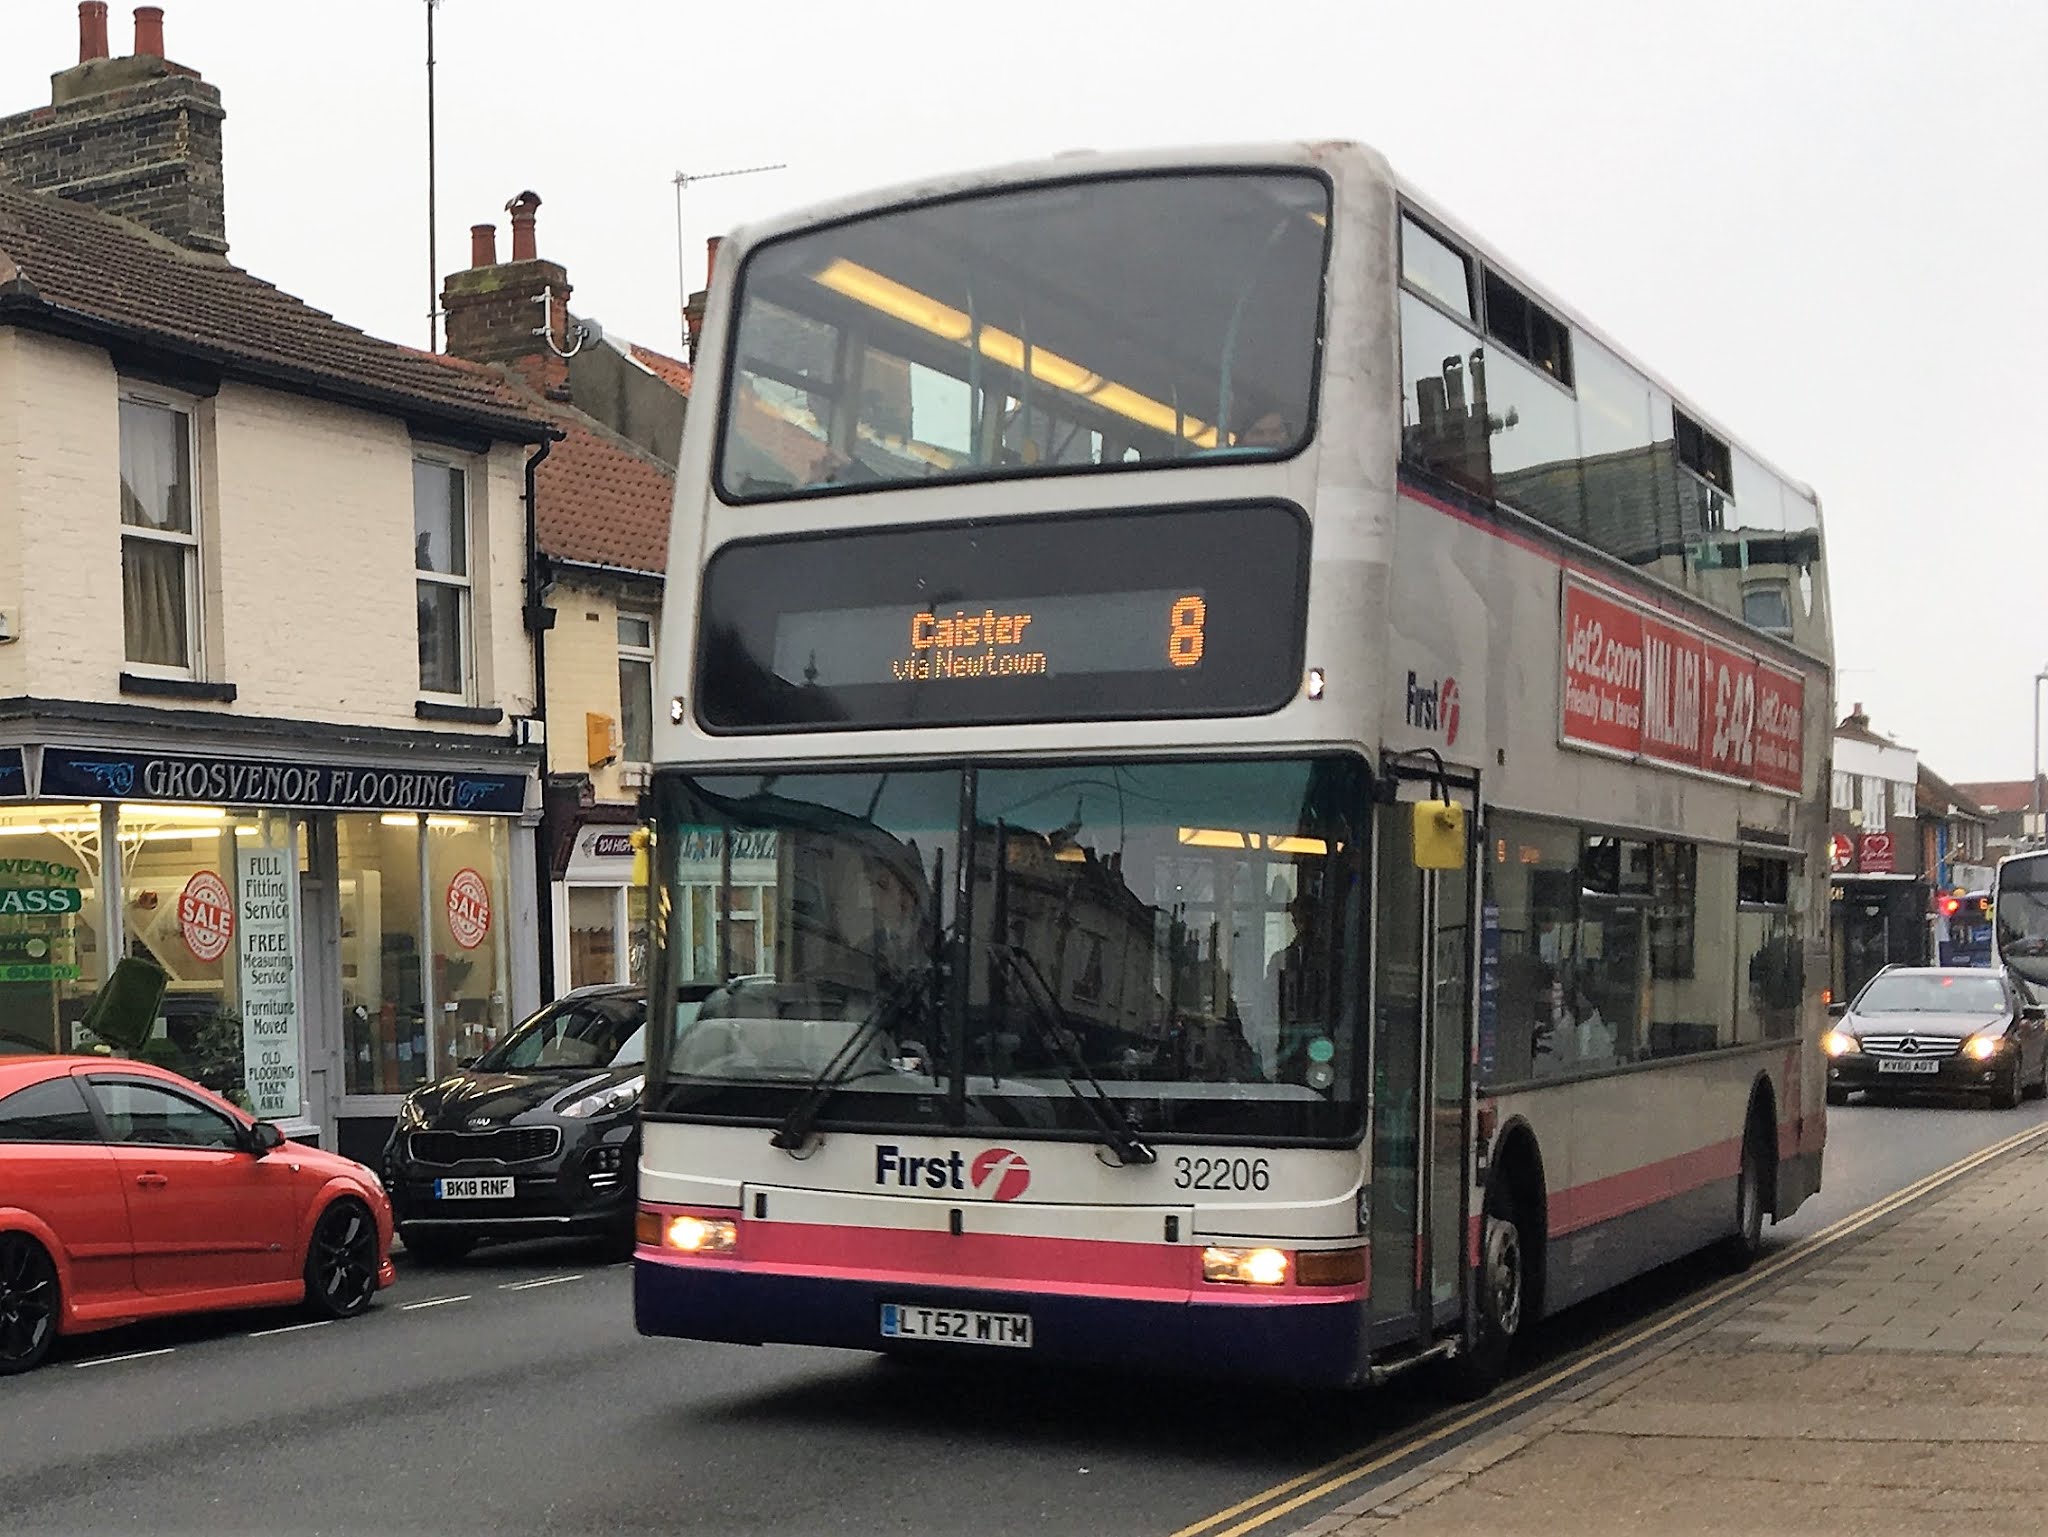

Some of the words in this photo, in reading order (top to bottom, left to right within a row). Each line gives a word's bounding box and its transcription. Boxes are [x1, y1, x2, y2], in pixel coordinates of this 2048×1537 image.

[911, 608, 1032, 650] Caister
[1168, 595, 1206, 667] 8
[893, 651, 930, 680] via
[935, 647, 1047, 679] Newtown
[1567, 614, 1641, 691] Jet2.com
[1406, 669, 1438, 731] First
[144, 760, 320, 802] GROSVENOR
[326, 770, 456, 807] FLOORING
[0, 858, 78, 882] VENOR
[250, 857, 281, 876] FULL
[0, 889, 71, 912] ASS
[246, 878, 288, 903] Fitting
[182, 898, 231, 936] SALE
[244, 900, 290, 920] Service
[449, 889, 488, 932] SALE
[249, 933, 287, 953] FREE
[243, 953, 294, 971] Measuring
[251, 968, 287, 985] Service
[245, 999, 295, 1016] Furniture
[254, 1018, 288, 1035] Moved
[262, 1050, 281, 1066] OLD
[249, 1065, 294, 1081] FLOORING
[258, 1081, 287, 1096] TAKEN
[260, 1096, 284, 1110] AWAY
[875, 1144, 965, 1190] First
[1174, 1156, 1270, 1192] 32206
[446, 1180, 477, 1197] BK18
[482, 1179, 509, 1196] RNF
[900, 1308, 968, 1338] LT52
[976, 1313, 1028, 1343] WTM
